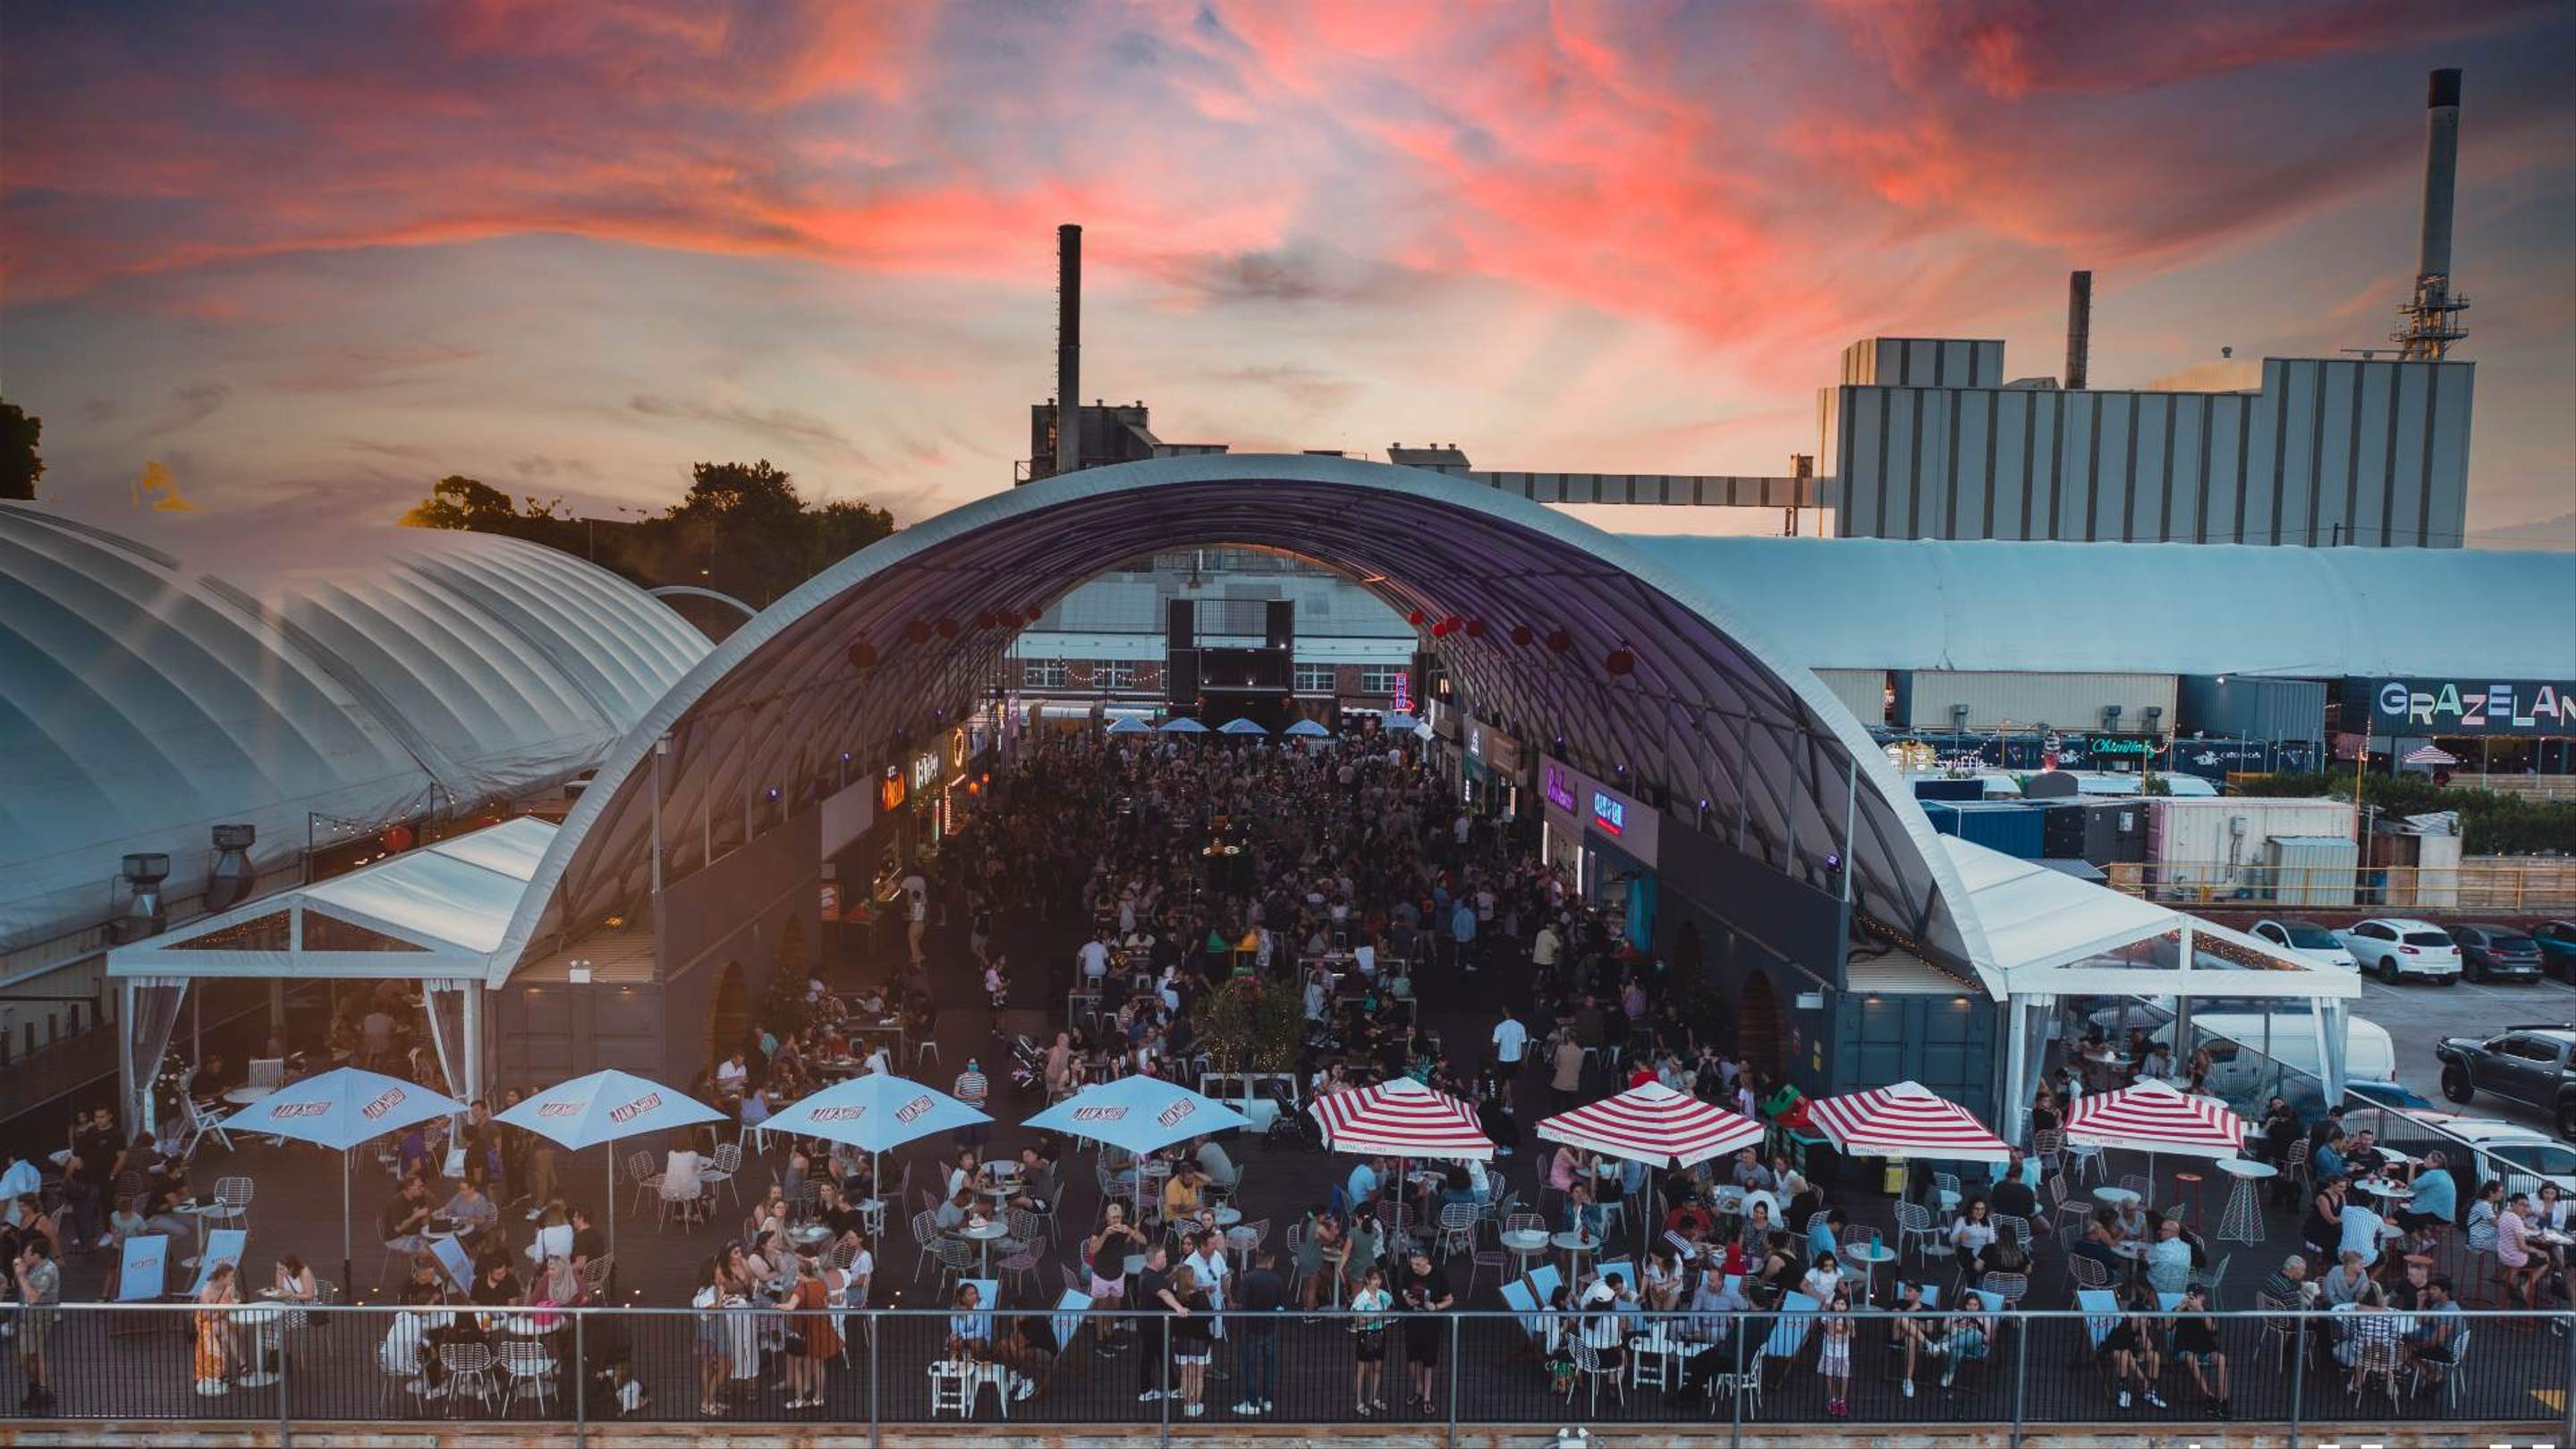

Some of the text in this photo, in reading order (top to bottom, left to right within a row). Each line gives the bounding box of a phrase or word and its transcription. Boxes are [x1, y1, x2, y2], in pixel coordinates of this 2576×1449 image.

[2380, 682, 2576, 726] GRAZELAN
[274, 1102, 327, 1117] JAM SHED
[364, 1089, 405, 1118] JAM SHED
[611, 1093, 661, 1124] JAM SHED
[811, 1109, 837, 1121] JAM
[897, 1095, 933, 1125] JAM SHED
[1075, 1108, 1099, 1120] JAM
[1159, 1110, 1178, 1127] JAM
